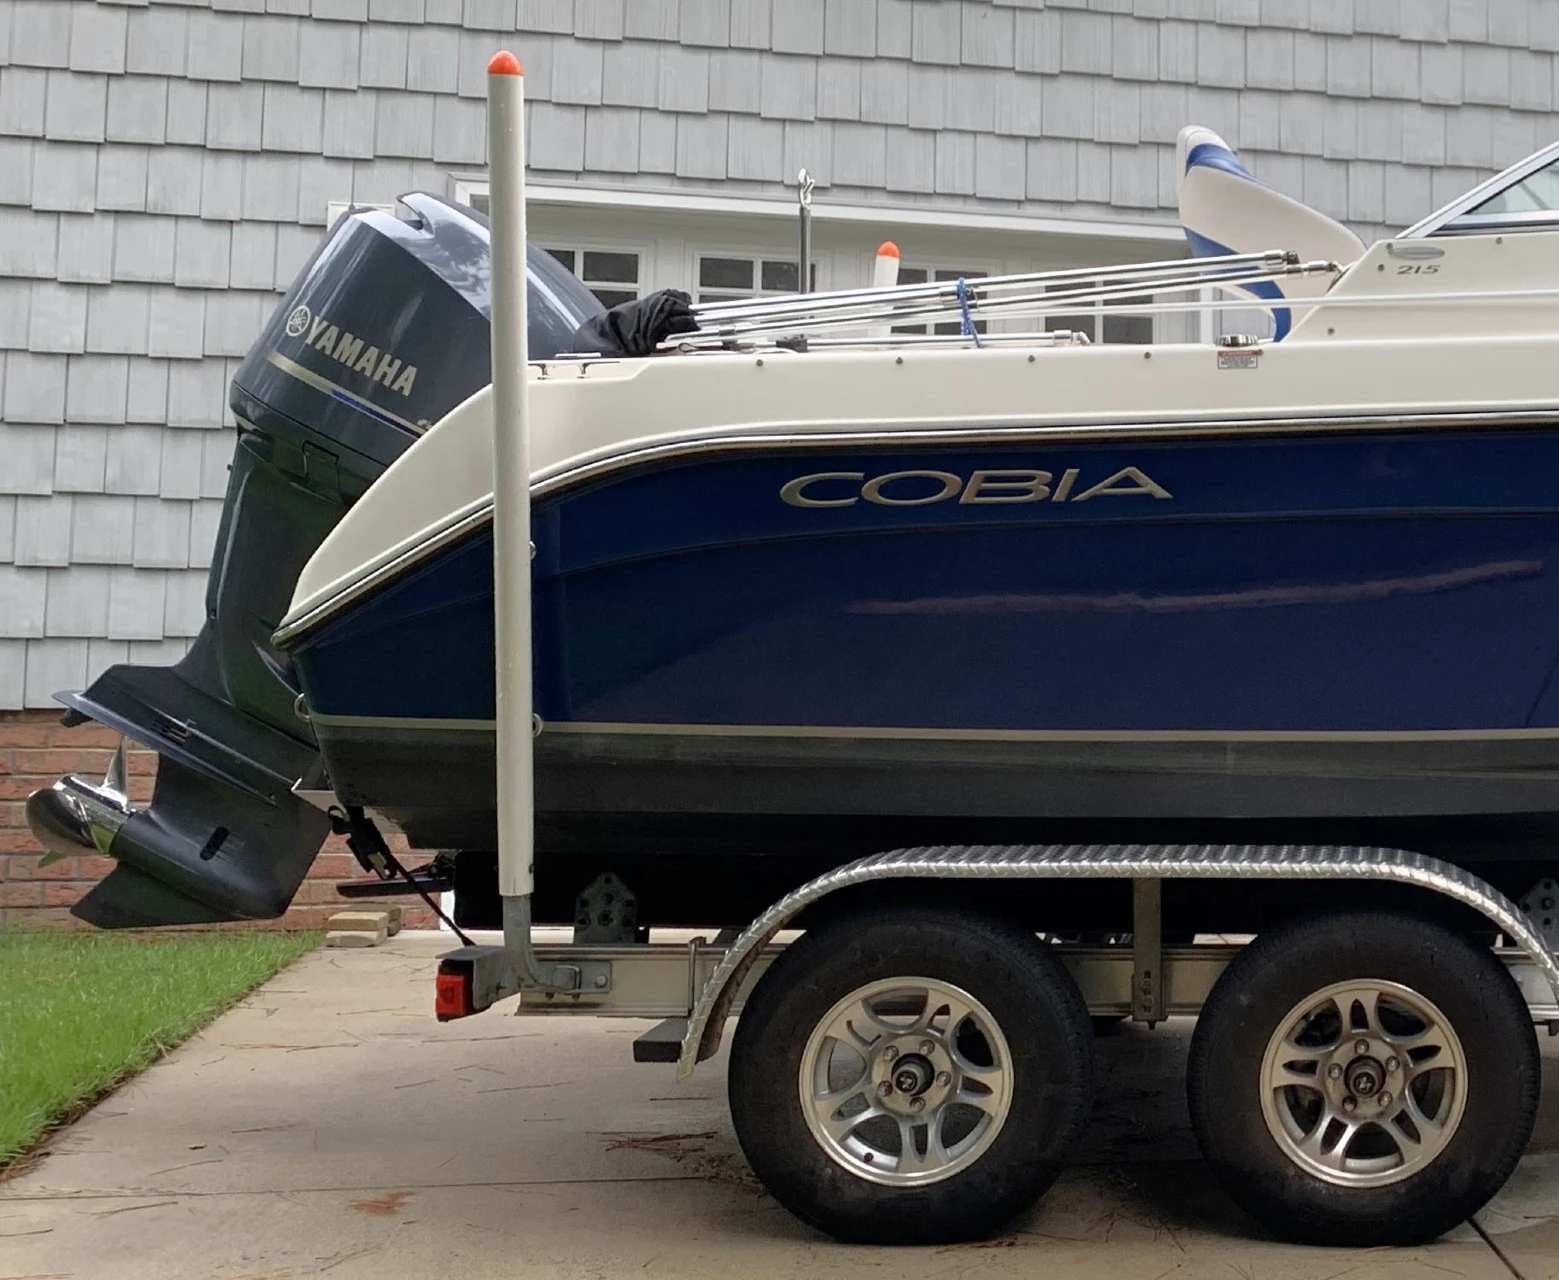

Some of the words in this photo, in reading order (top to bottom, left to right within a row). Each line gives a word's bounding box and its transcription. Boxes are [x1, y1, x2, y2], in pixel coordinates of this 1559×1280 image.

[1396, 264, 1441, 275] 215
[305, 315, 418, 397] YAMAHA
[779, 466, 1173, 508] COBIA
